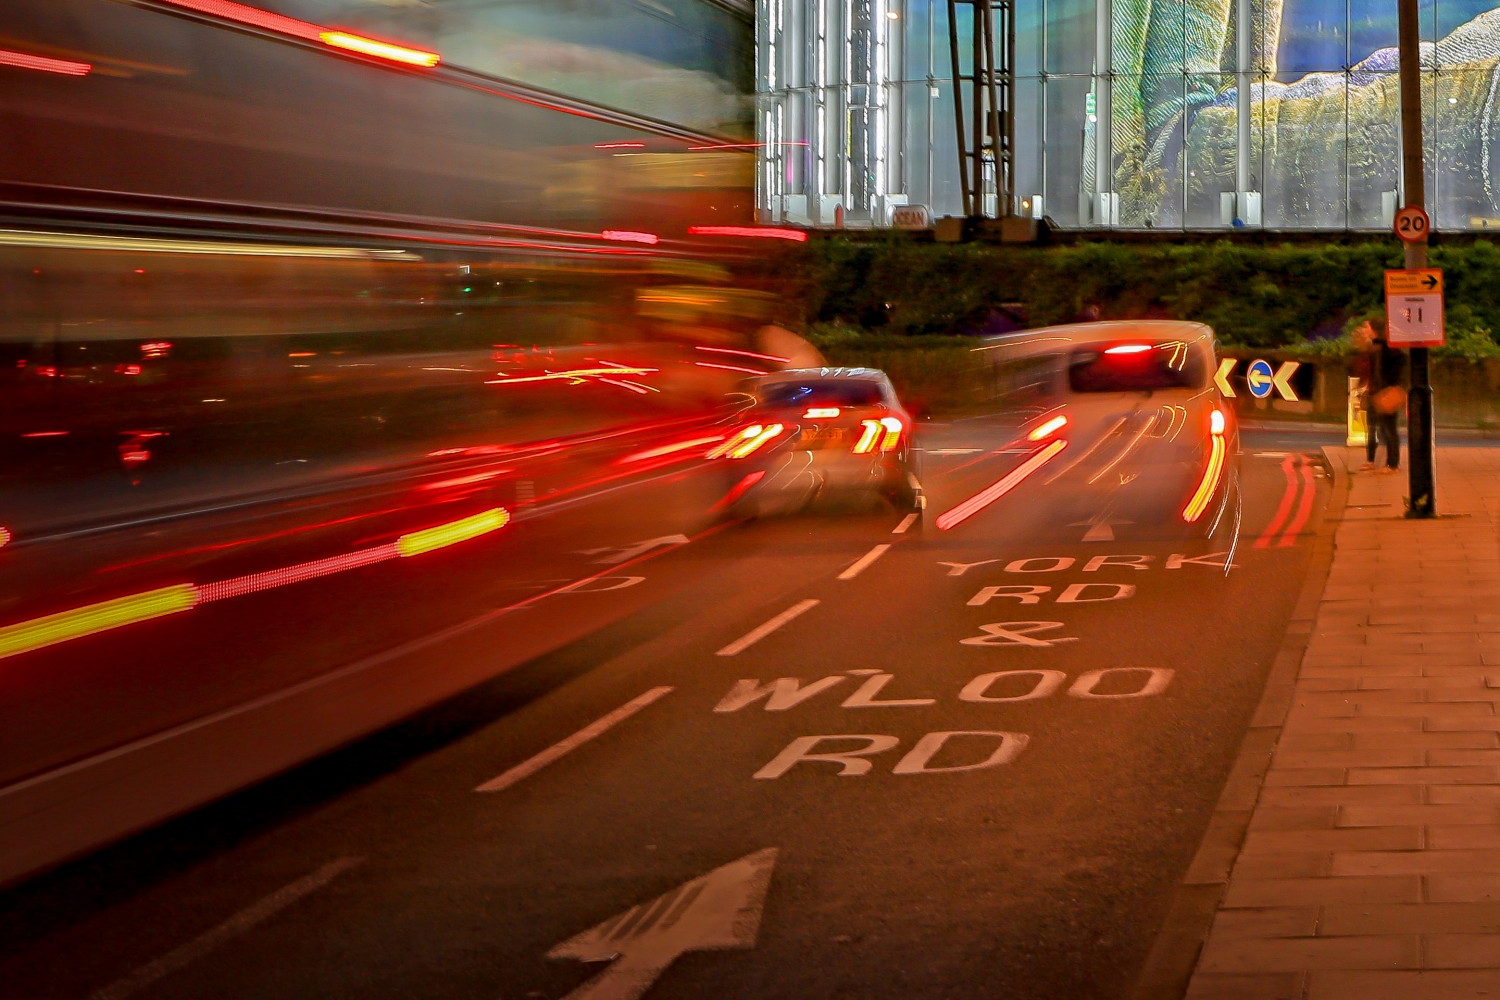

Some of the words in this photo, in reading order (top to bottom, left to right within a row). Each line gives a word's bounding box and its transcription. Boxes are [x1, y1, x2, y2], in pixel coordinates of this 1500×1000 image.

[1400, 216, 1424, 232] 20
[936, 552, 1240, 576] YORK
[966, 583, 1136, 606] RD
[959, 621, 1080, 647] &
[753, 730, 1031, 780] RD
